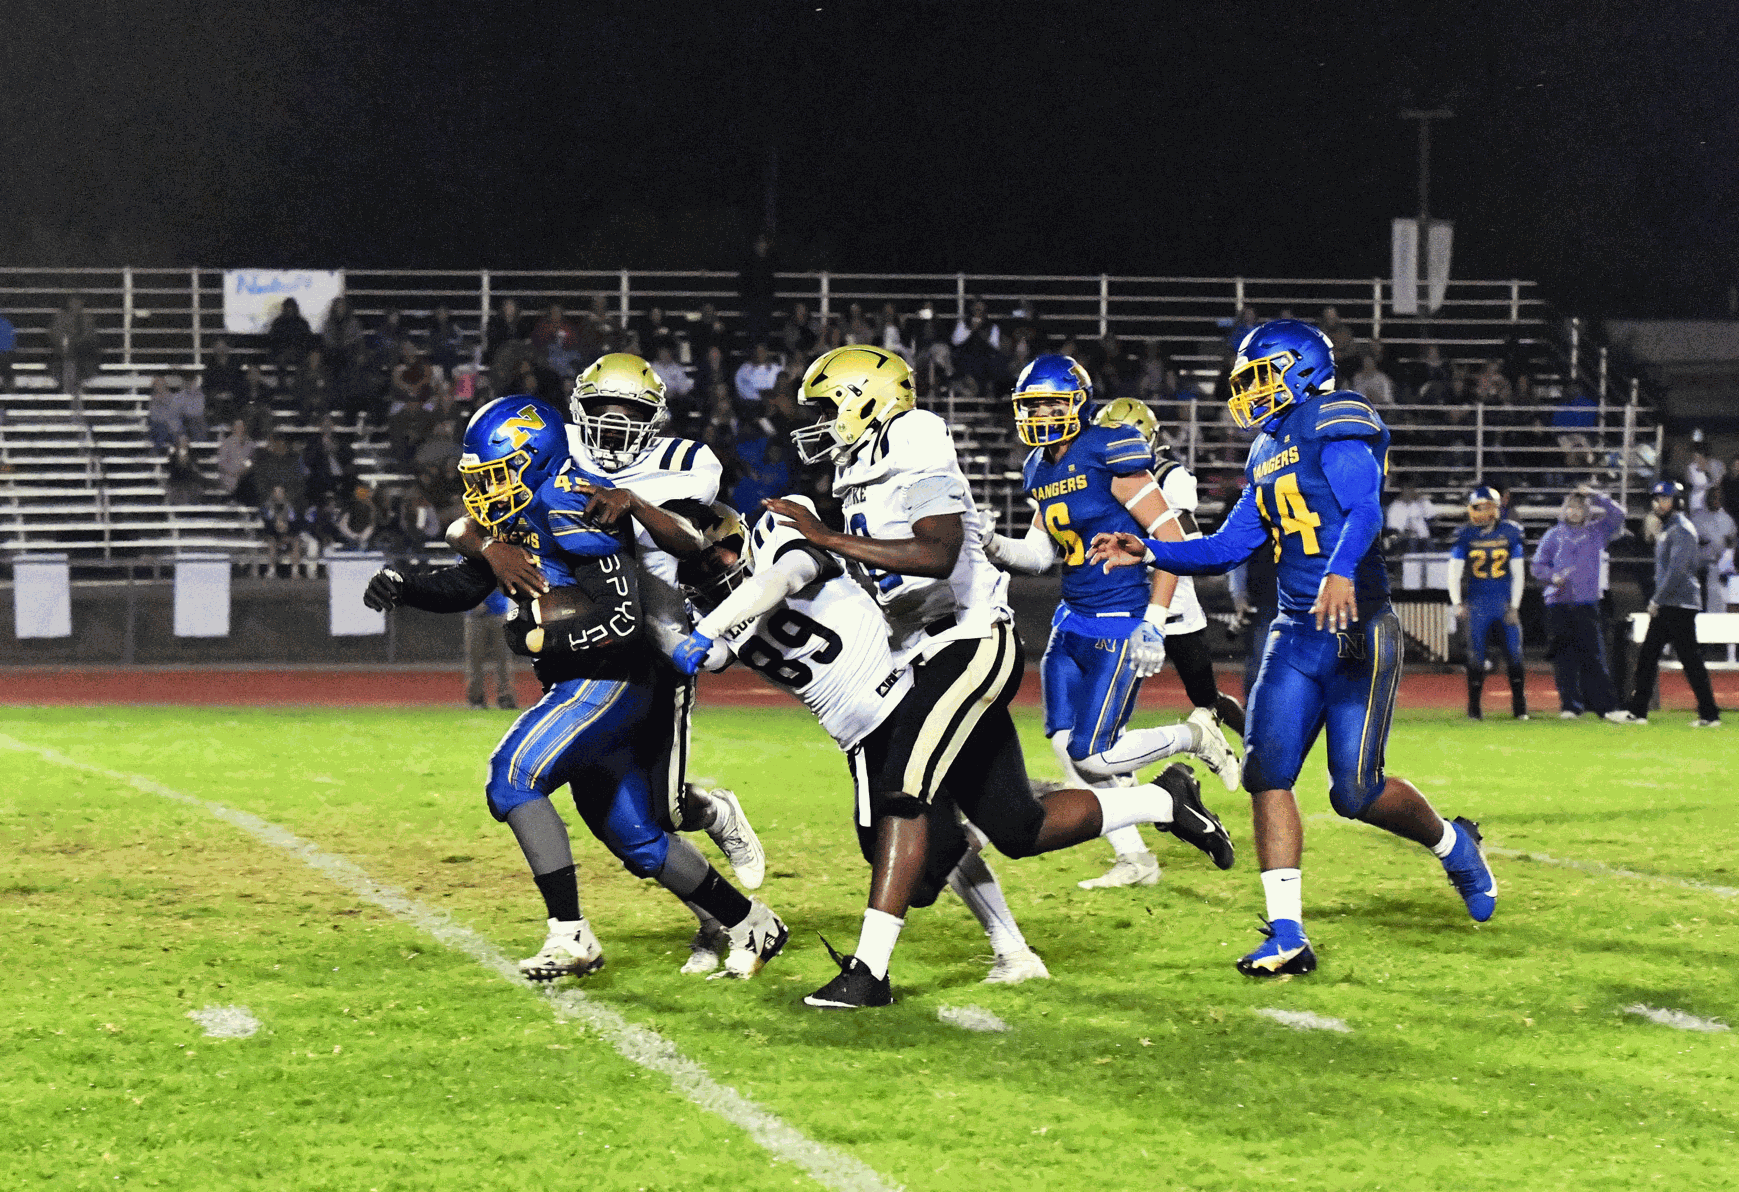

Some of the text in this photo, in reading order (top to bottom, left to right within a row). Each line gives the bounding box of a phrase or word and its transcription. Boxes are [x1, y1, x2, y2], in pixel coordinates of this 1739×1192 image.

[496, 403, 547, 450] N
[1045, 501, 1085, 566] 6
[1255, 472, 1321, 563] 4
[1468, 548, 1509, 579] 22
[738, 607, 843, 688] 89
[1336, 632, 1366, 659] N
